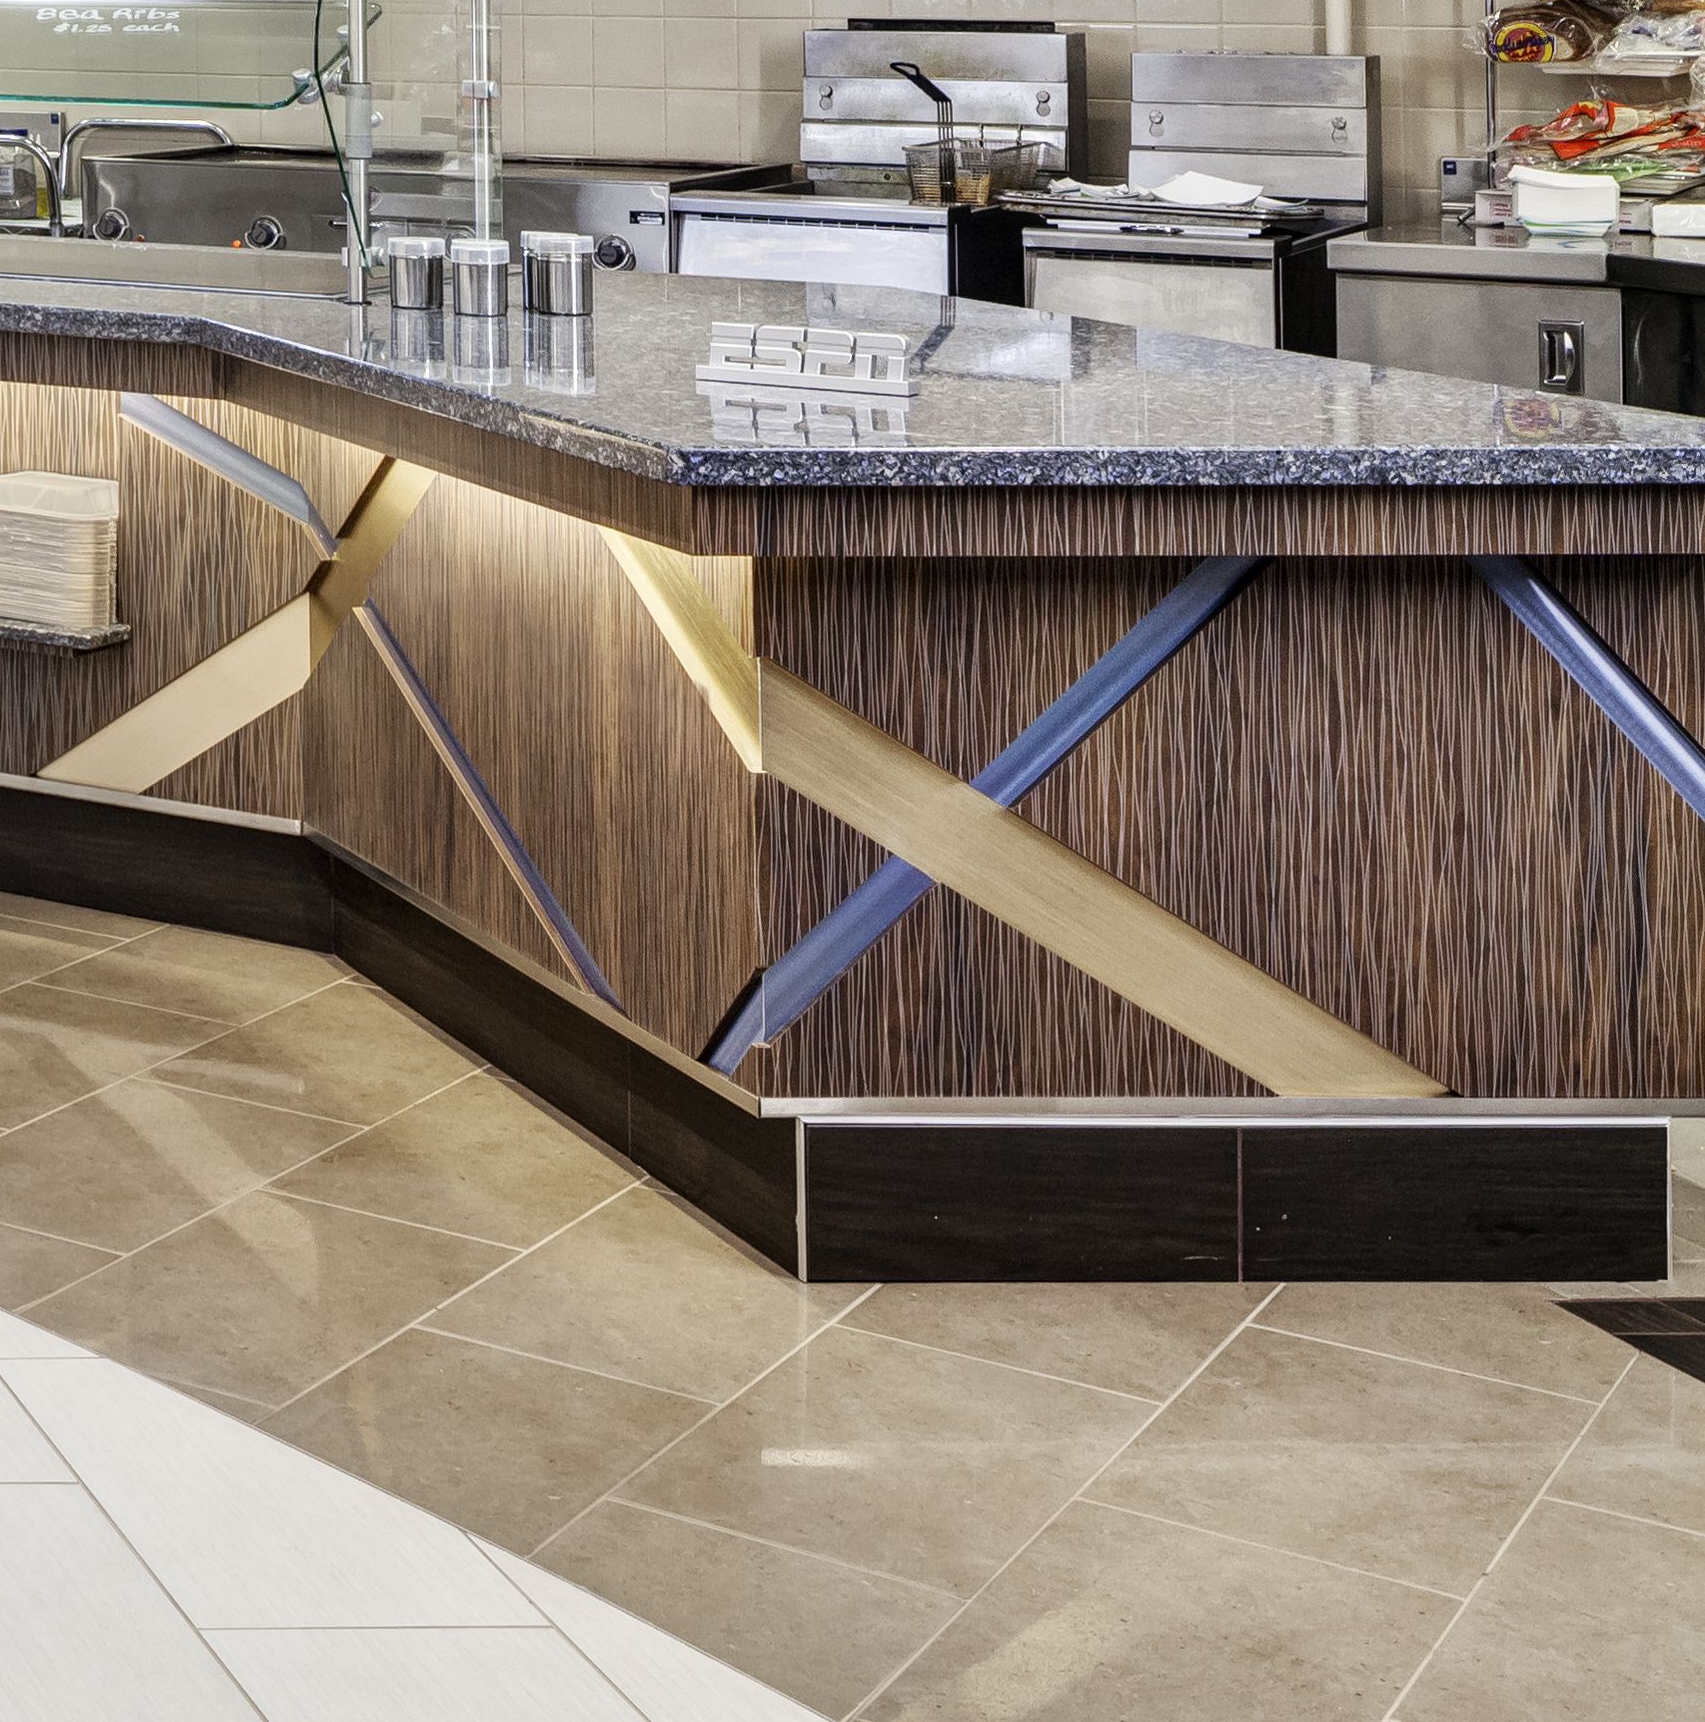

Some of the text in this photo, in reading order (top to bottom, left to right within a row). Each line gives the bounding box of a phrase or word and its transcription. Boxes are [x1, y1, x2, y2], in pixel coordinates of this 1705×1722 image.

[36, 7, 104, 20] BBQ
[122, 22, 181, 32] each
[709, 321, 909, 382] ESPN
